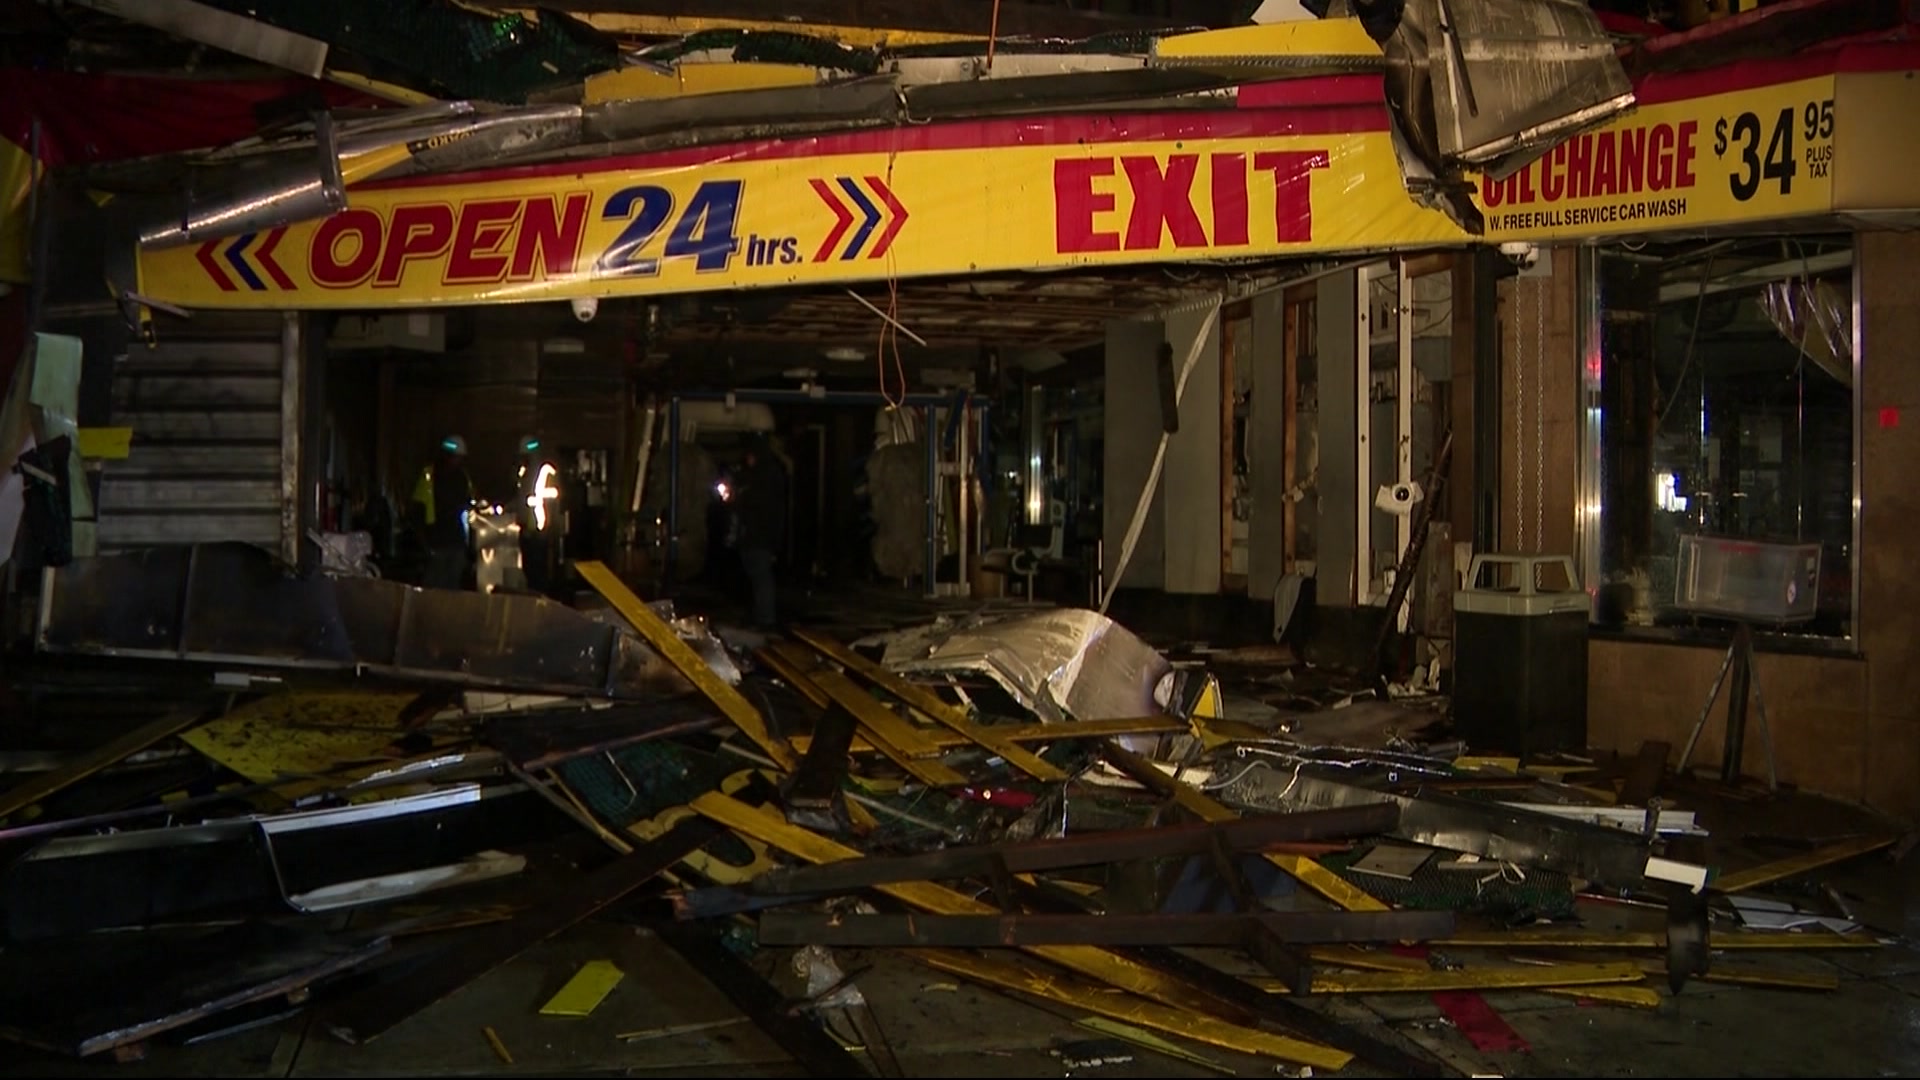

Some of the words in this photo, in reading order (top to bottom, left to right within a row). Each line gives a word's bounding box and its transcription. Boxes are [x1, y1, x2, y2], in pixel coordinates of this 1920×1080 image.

[1804, 100, 1834, 141] 95
[1541, 120, 1698, 202] CHANGE
[1805, 145, 1833, 163] PLUS
[1809, 162, 1828, 179] TAX
[1054, 149, 1330, 253] EXIT
[1503, 212, 1533, 230] FREE
[1534, 210, 1564, 228] FULL
[1564, 205, 1618, 226] SERVICE
[1619, 201, 1646, 221] CAR
[1647, 198, 1687, 218] WASH
[309, 191, 592, 289] OPEN
[592, 178, 746, 279] 24
[746, 234, 803, 267] hrs.
